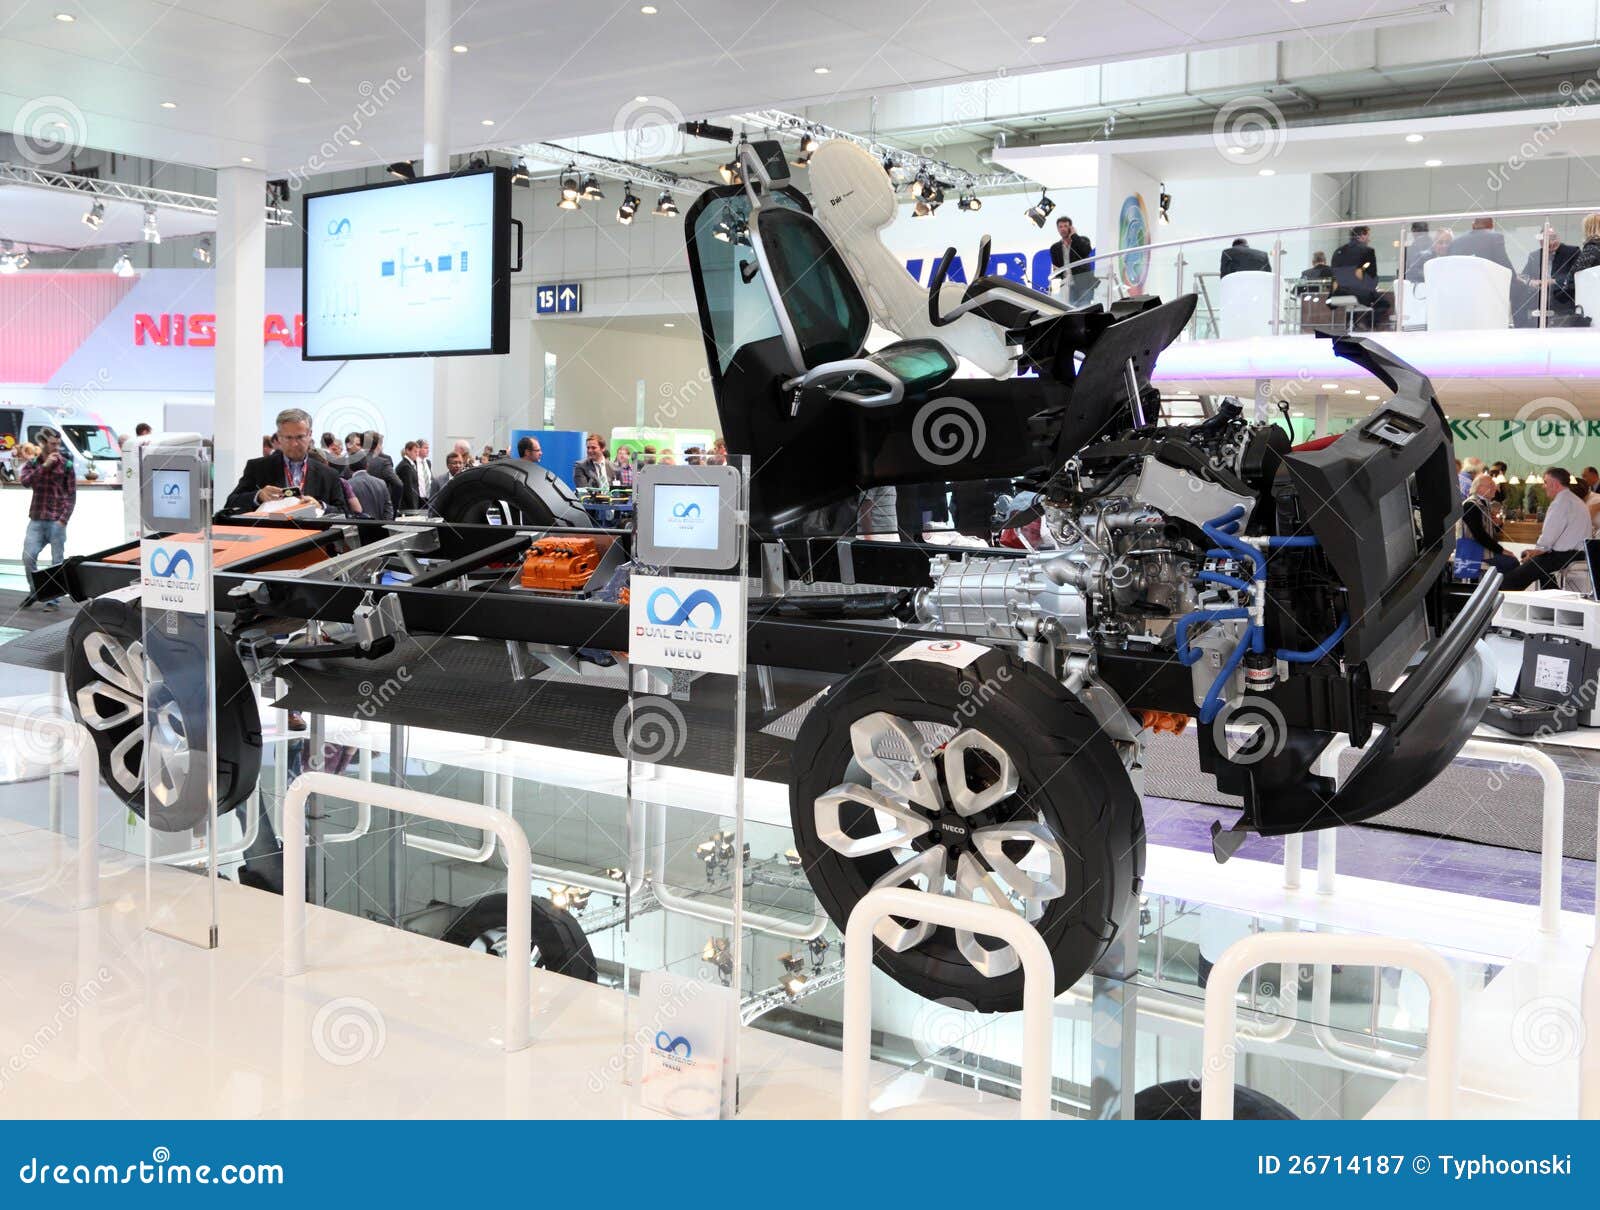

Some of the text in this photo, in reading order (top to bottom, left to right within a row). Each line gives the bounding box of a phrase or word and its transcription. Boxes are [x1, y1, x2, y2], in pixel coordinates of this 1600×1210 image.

[539, 290, 554, 308] 15
[134, 313, 304, 348] NISA
[166, 580, 200, 591] ENERGY
[636, 626, 732, 645] DUAL ENERGY
[664, 647, 702, 660] IVECO
[942, 823, 965, 835] IVECO
